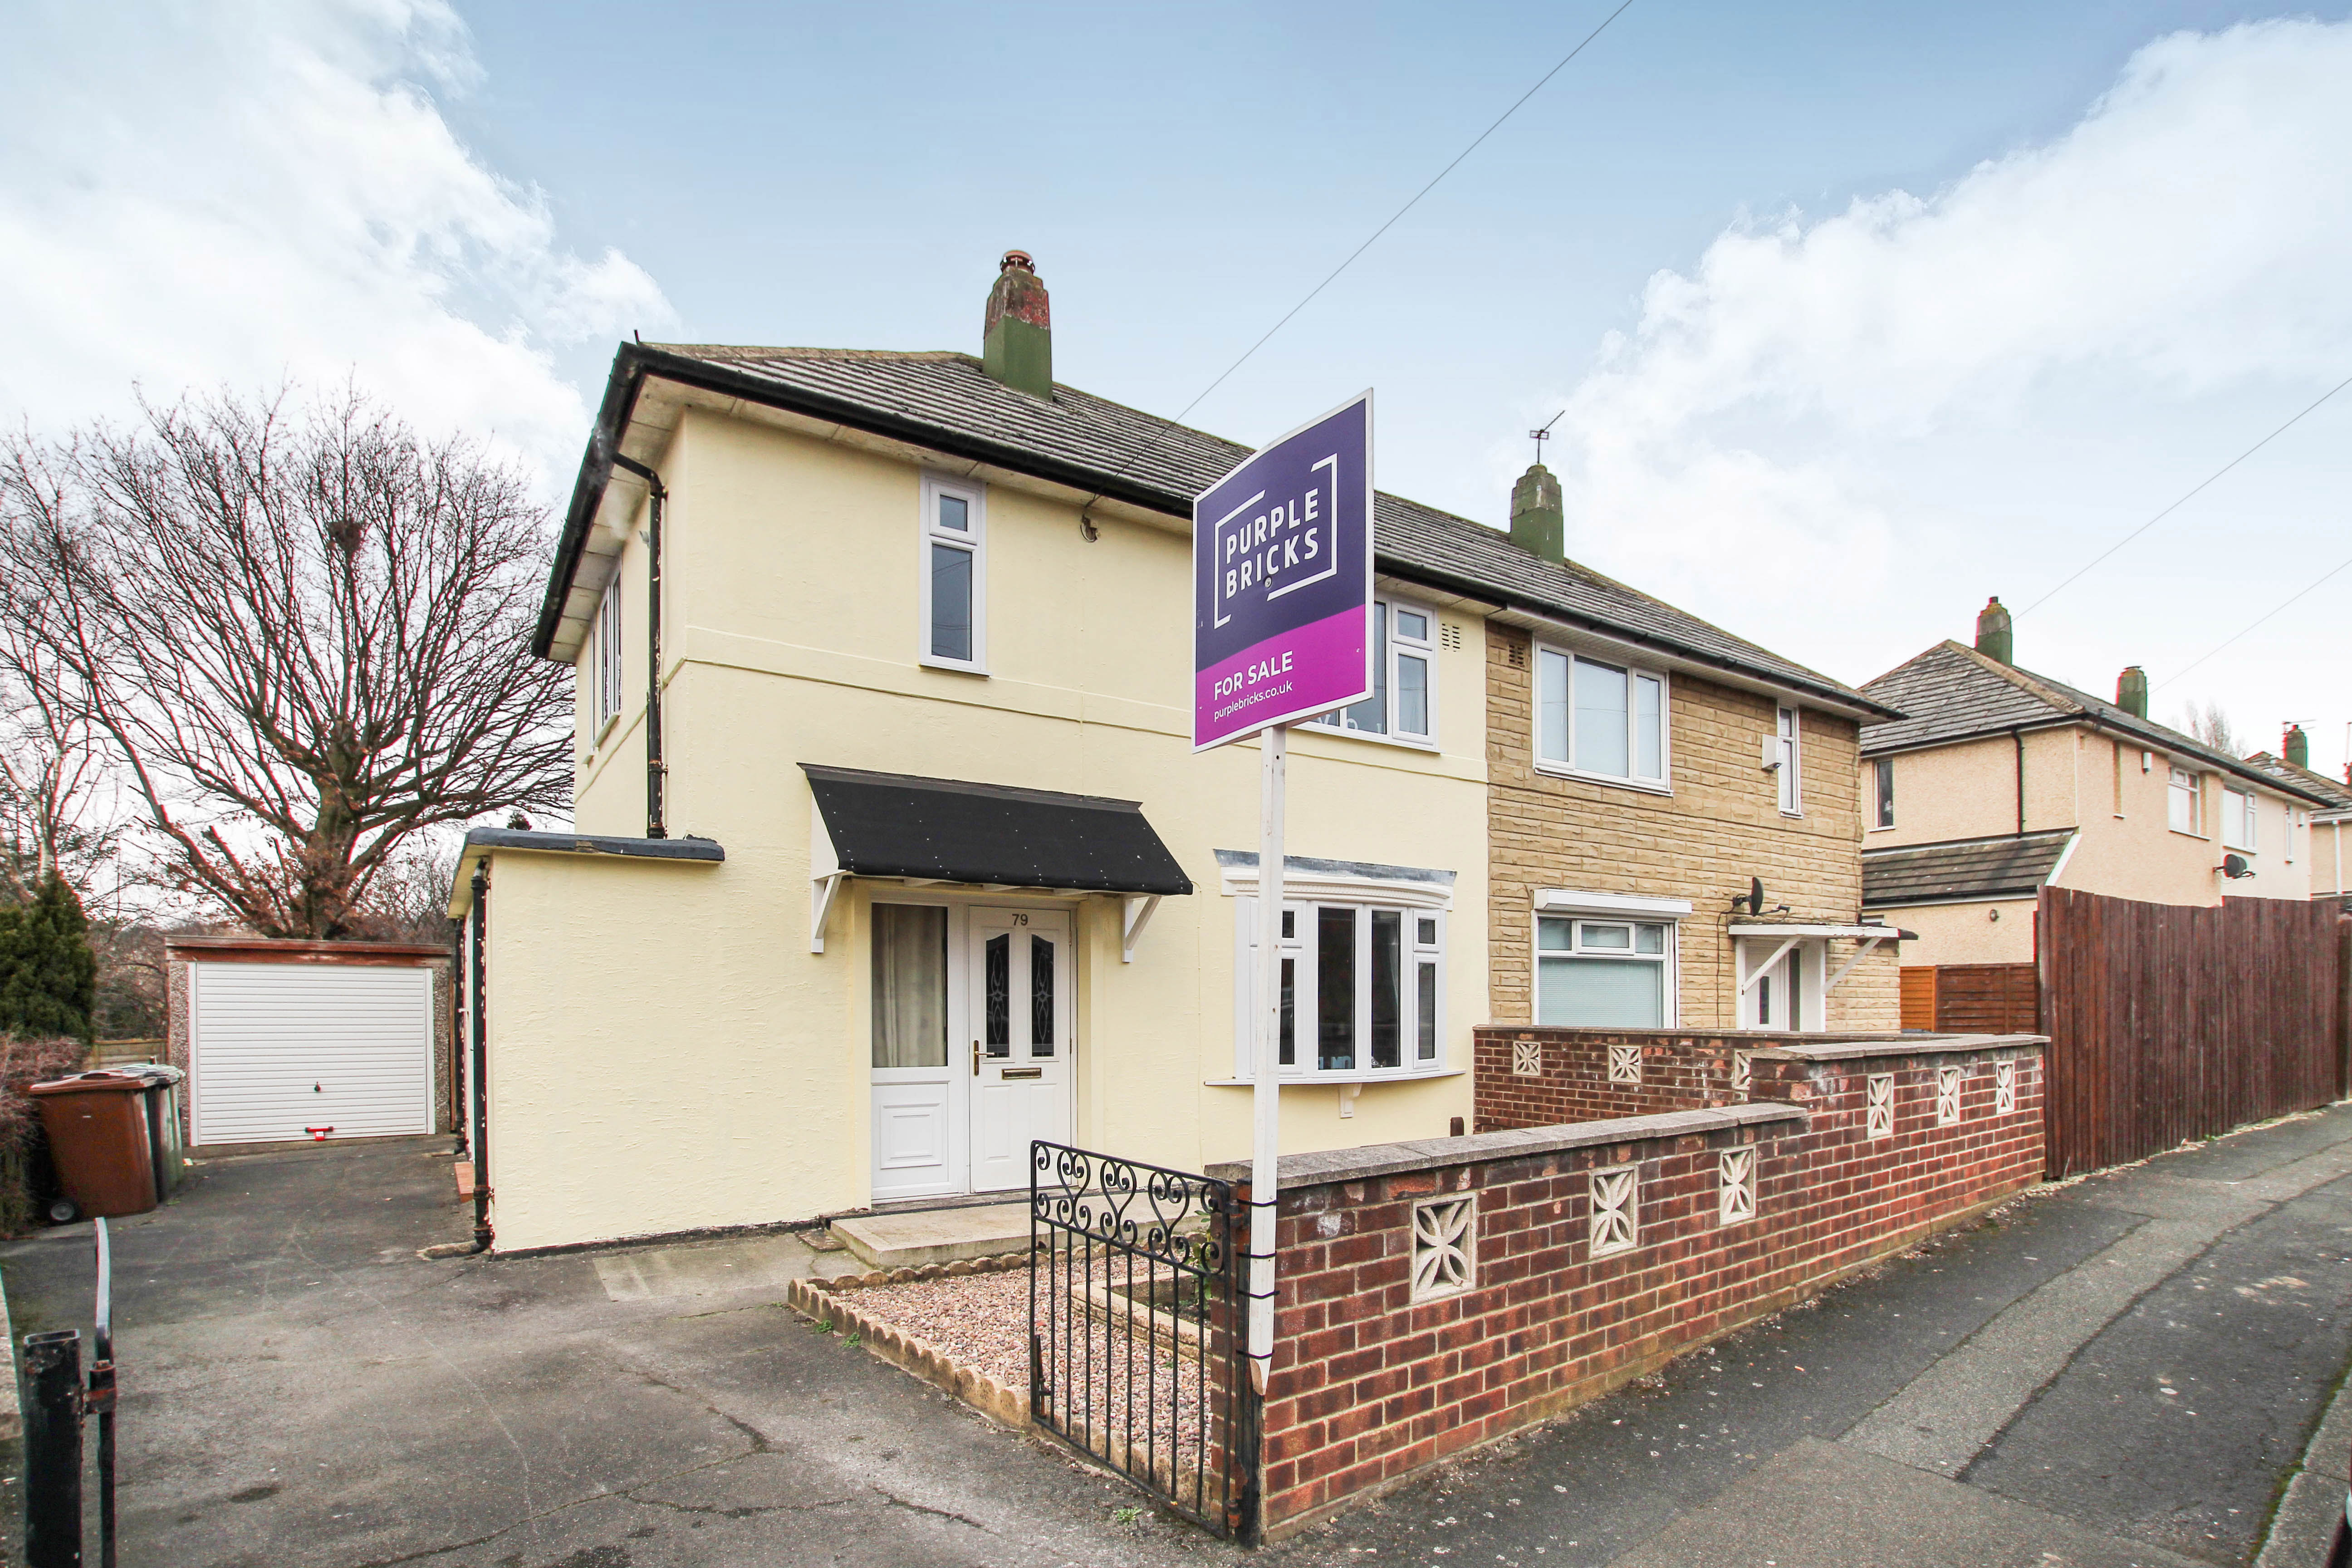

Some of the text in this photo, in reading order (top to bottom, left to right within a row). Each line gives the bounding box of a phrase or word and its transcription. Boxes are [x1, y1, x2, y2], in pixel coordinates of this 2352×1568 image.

[1226, 488, 1318, 564] PURPLE
[1226, 527, 1319, 599] BRICKS
[1214, 650, 1293, 701] FOR SALE
[1214, 680, 1293, 722] purplebricks.co.uk
[1012, 914, 1028, 926] 79
